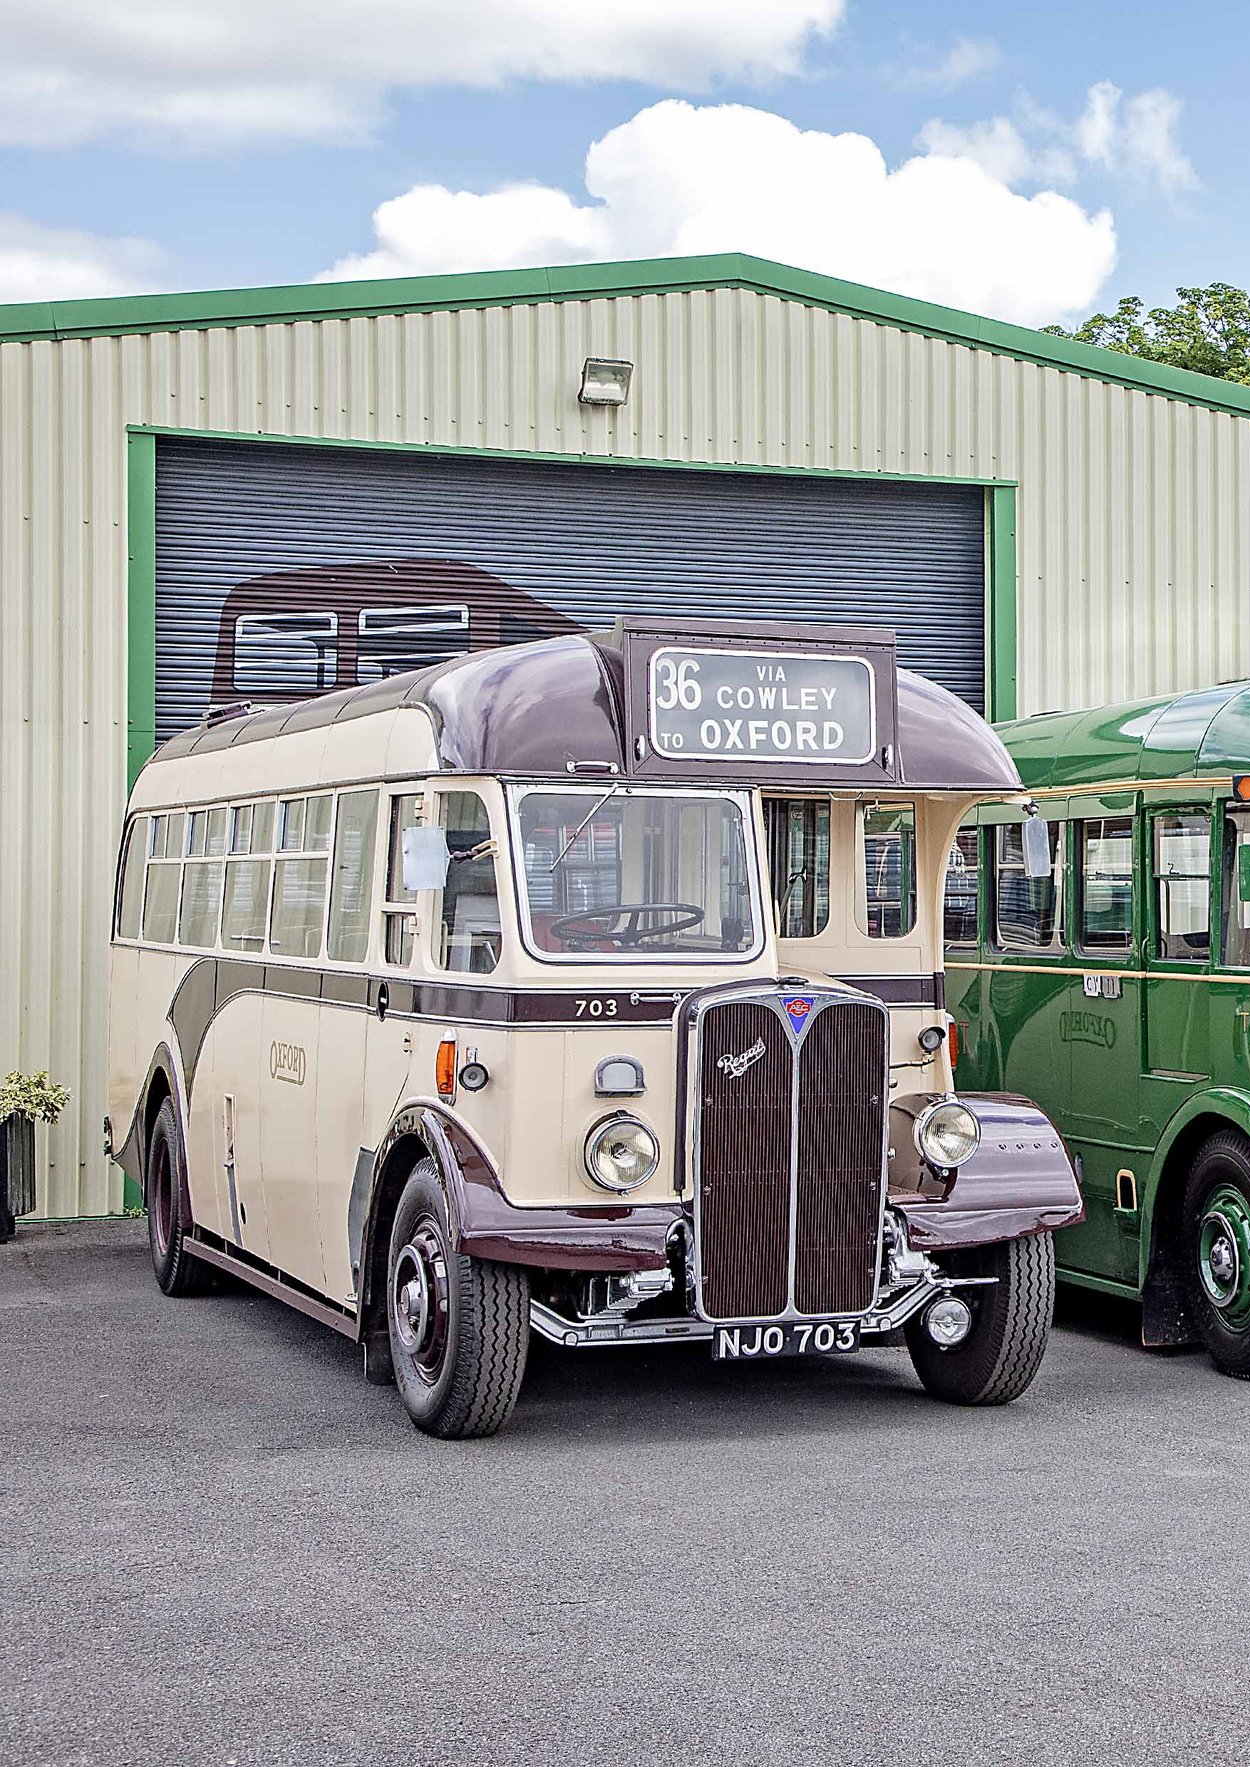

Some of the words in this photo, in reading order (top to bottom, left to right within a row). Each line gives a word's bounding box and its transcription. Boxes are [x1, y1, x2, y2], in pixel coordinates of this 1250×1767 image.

[656, 658, 700, 710] 36
[756, 666, 786, 682] VIA
[716, 686, 837, 711] COWLEY
[661, 733, 684, 748] TO
[700, 719, 844, 750] OXFORD
[575, 999, 618, 1017] 703
[270, 1040, 306, 1085] OXFORD
[719, 1326, 784, 1358] NJO
[794, 1322, 856, 1352] 703
